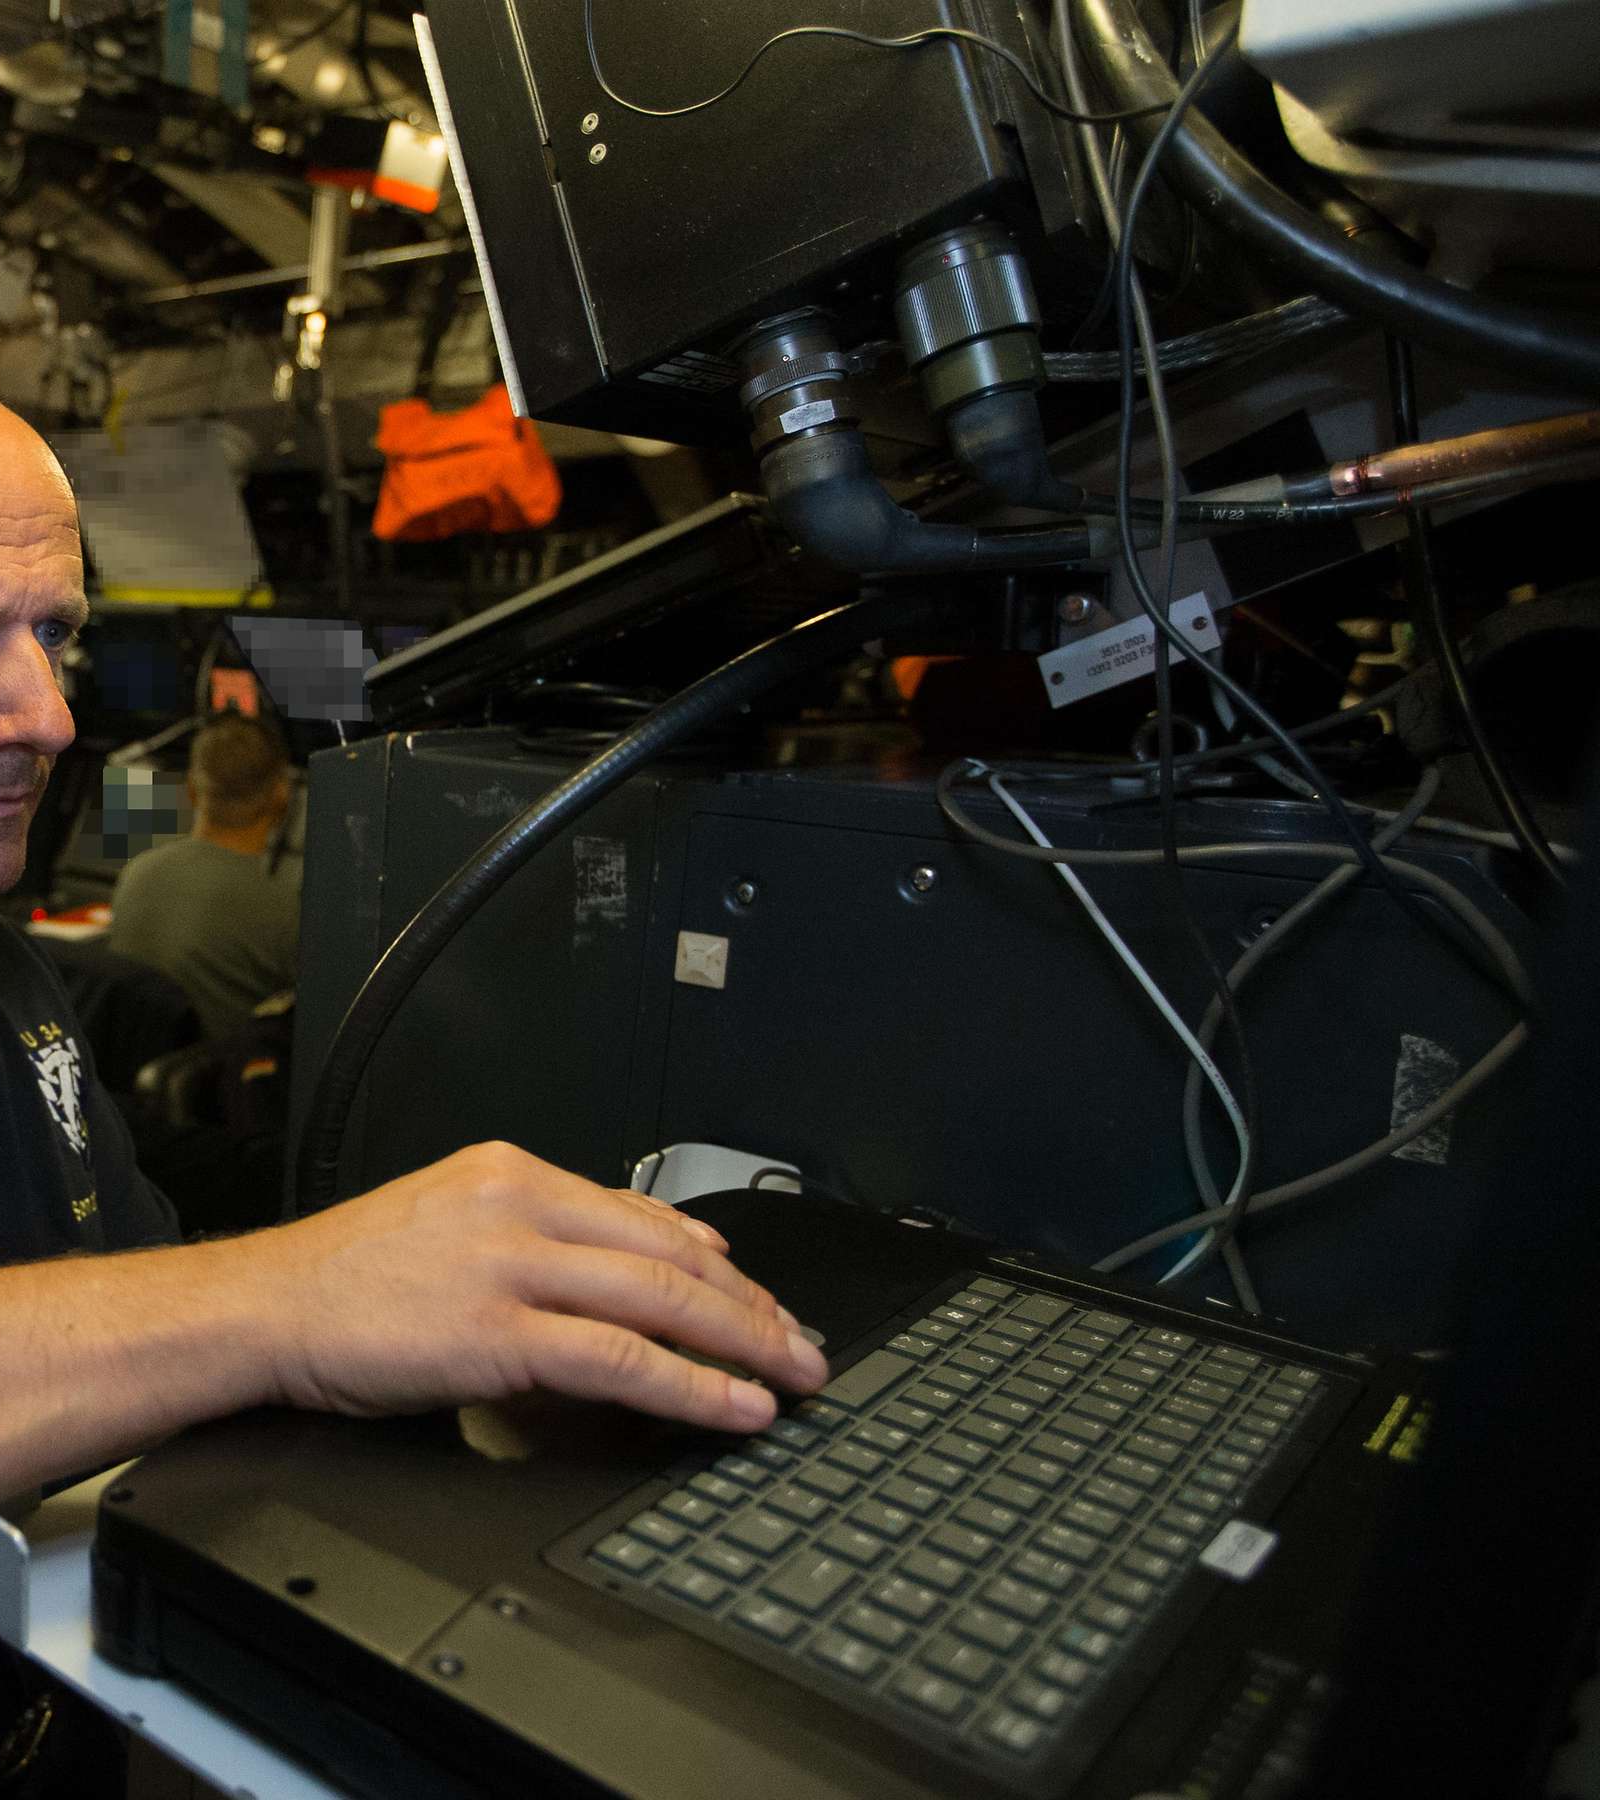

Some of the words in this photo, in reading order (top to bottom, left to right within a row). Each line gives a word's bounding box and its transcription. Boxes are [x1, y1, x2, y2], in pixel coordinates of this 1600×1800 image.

[1228, 510, 1245, 520] 22
[19, 1032, 38, 1048] U
[39, 1021, 62, 1041] 34
